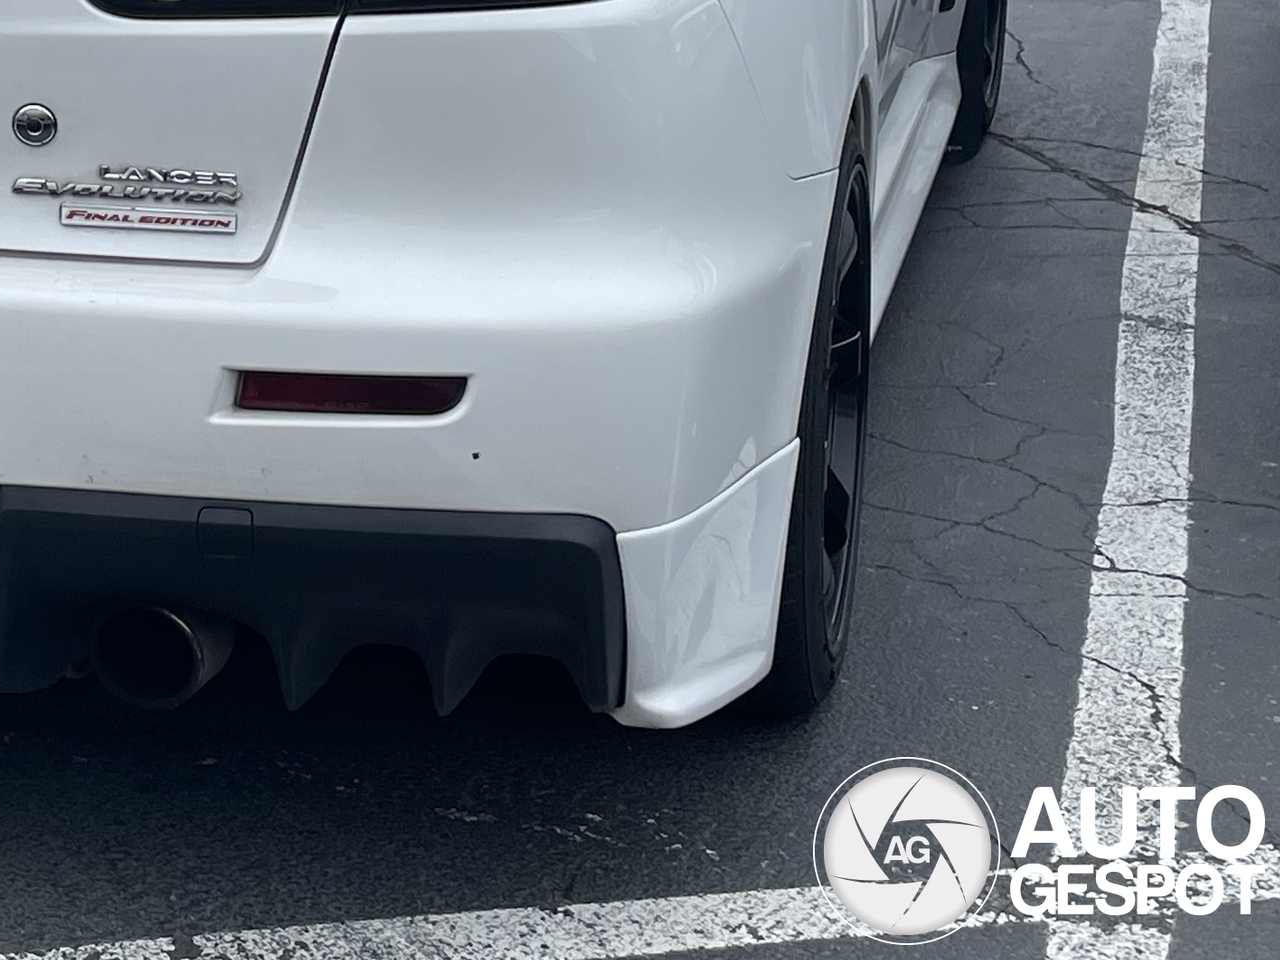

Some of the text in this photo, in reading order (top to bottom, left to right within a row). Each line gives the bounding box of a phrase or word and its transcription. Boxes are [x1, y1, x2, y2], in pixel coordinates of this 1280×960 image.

[99, 164, 239, 187] LANCER
[12, 177, 243, 205] EVOLUTION
[65, 209, 232, 229] FINAL EDITION
